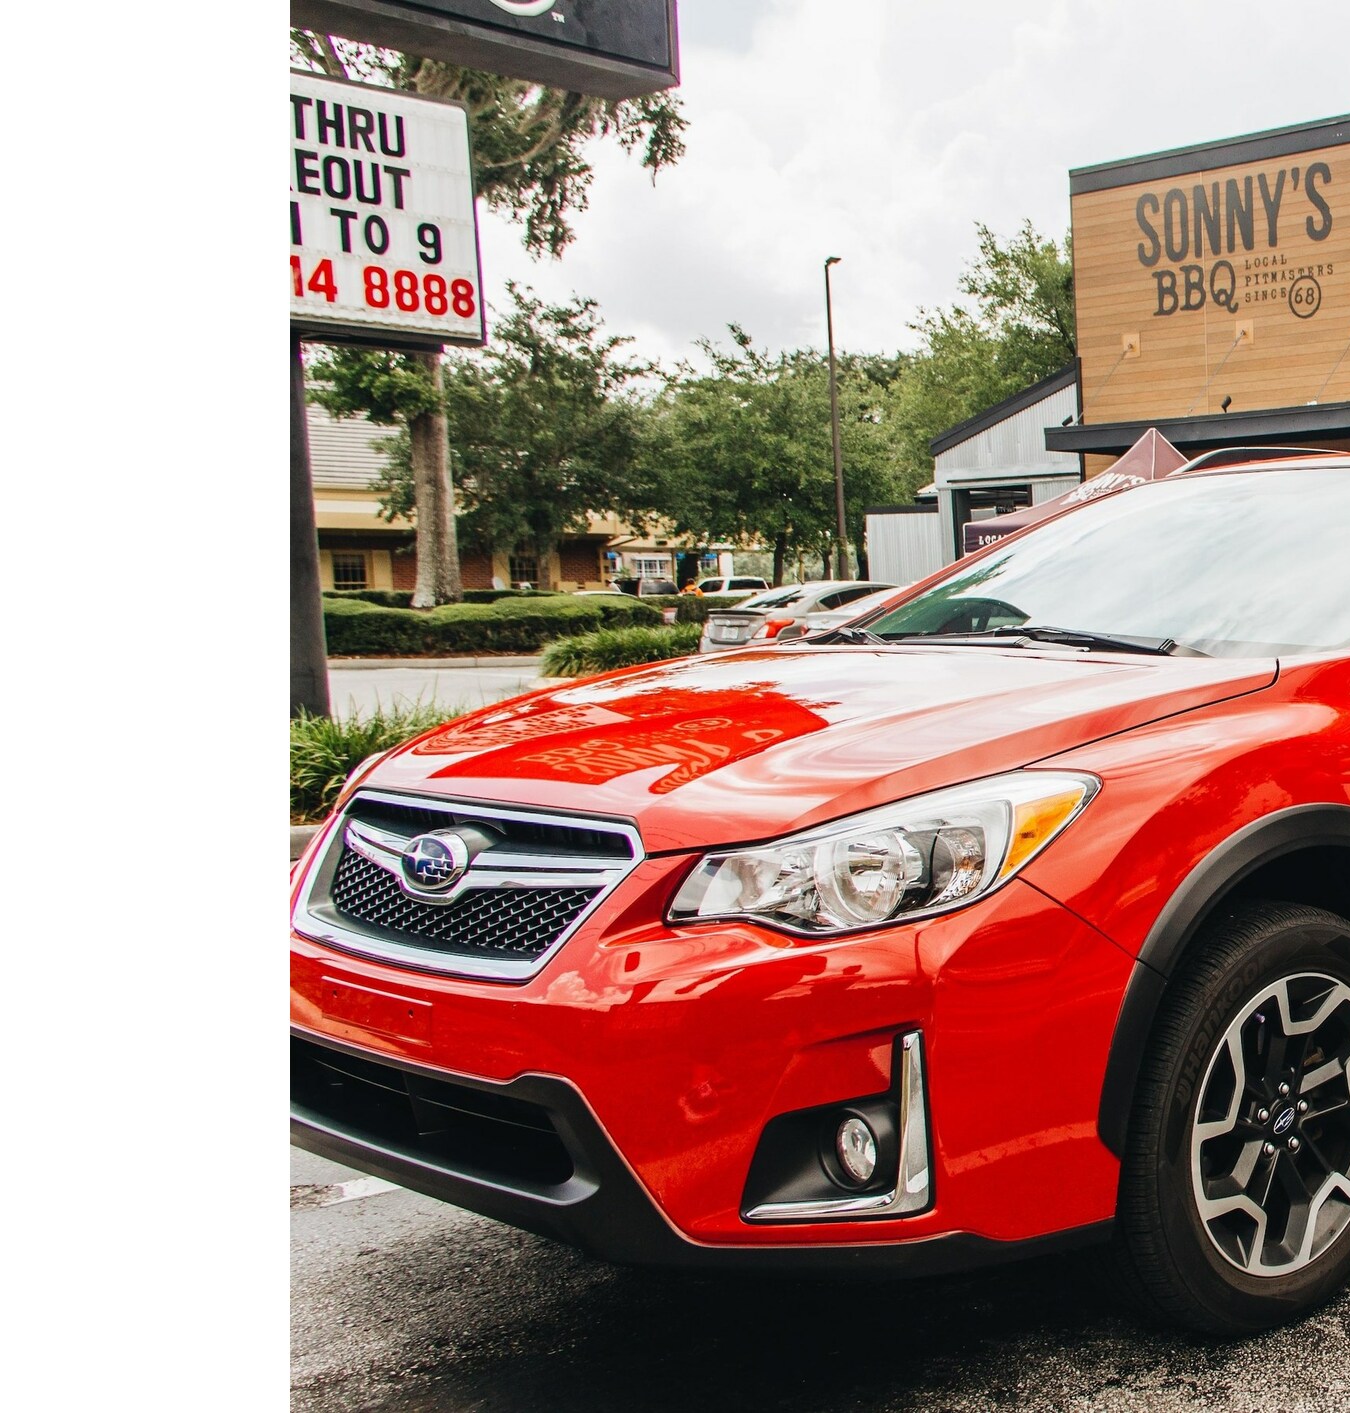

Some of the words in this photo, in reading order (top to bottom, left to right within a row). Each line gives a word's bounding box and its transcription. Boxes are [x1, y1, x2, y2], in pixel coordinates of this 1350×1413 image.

[290, 94, 406, 158] THRU
[290, 148, 411, 209] EOUT
[330, 207, 389, 255] TO
[417, 223, 443, 265] 9
[1136, 162, 1333, 267] SONNY'S
[1152, 260, 1239, 316] BBQ
[1245, 254, 1287, 270] LOCAL
[1245, 264, 1334, 287] PITMASTERS
[363, 266, 476, 318] 8888
[1245, 287, 1287, 303] SINCE
[1294, 287, 1315, 305] 68
